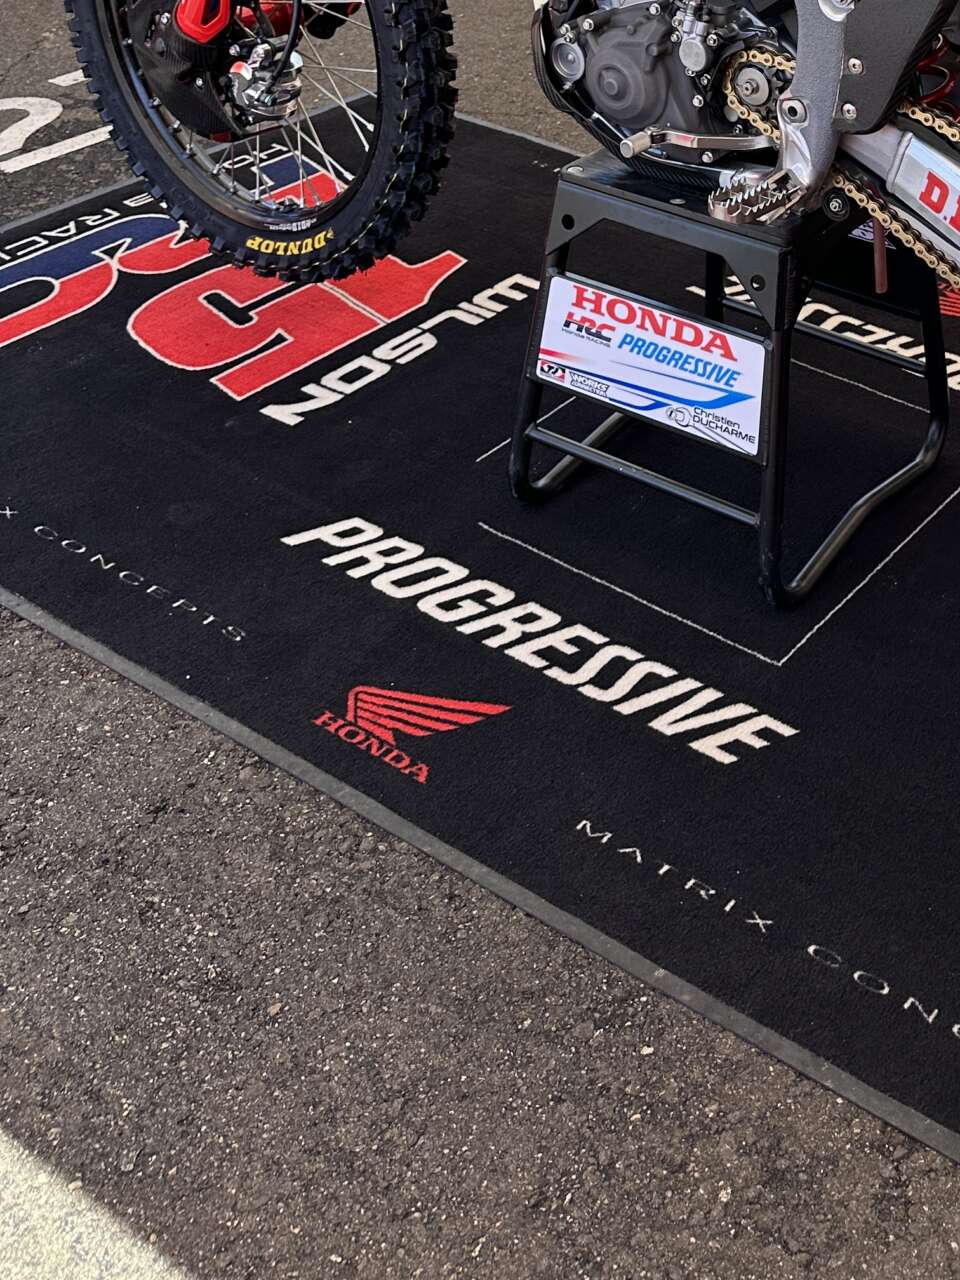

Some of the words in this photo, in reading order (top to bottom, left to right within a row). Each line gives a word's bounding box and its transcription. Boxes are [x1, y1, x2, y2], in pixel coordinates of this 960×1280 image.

[246, 231, 328, 257] DUNLOP
[258, 272, 541, 427] WILSON
[562, 311, 616, 342] HRC
[570, 284, 738, 363] HONDA
[617, 333, 742, 388] PROGRESSIVE
[692, 415, 757, 444] DUCHARME
[693, 407, 741, 430] Christien
[34, 525, 246, 642] CONCEPTS
[280, 516, 800, 765] PROGRESSIVE
[312, 710, 430, 784] HONDA
[576, 819, 774, 933] MATRIX
